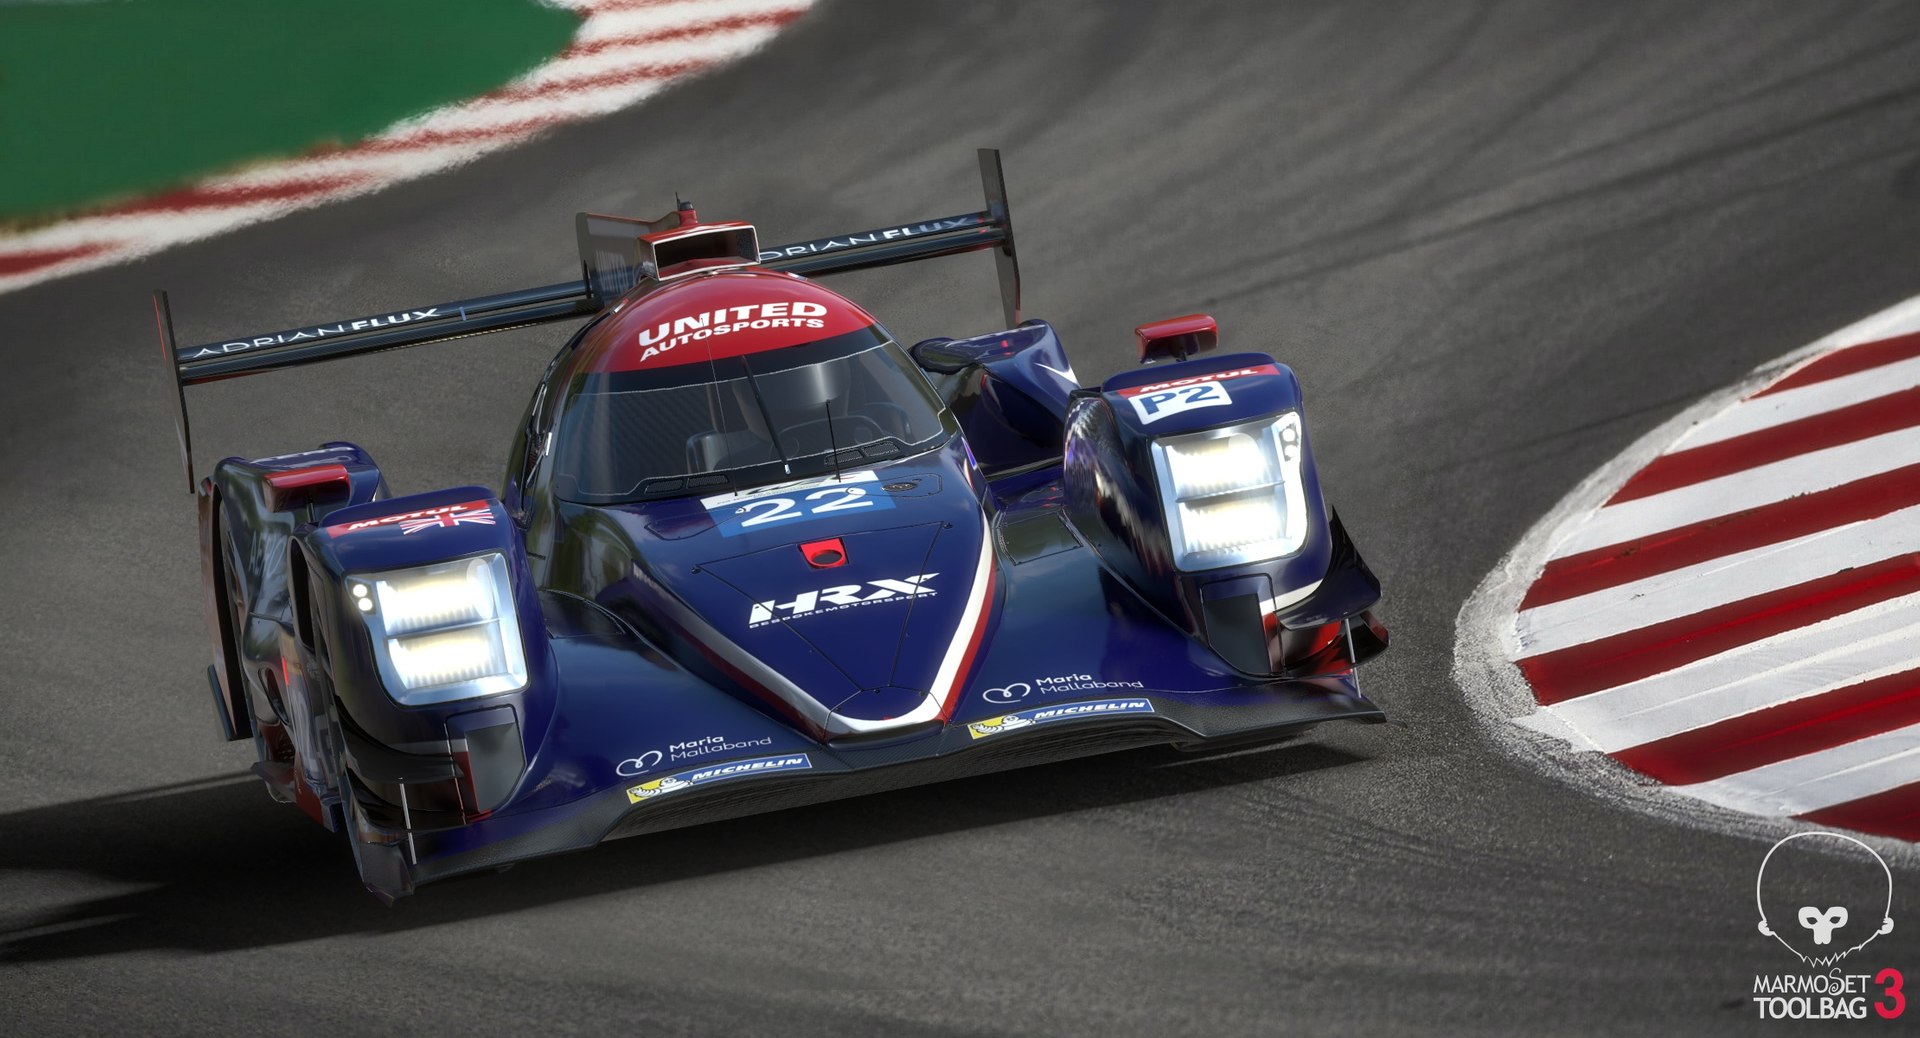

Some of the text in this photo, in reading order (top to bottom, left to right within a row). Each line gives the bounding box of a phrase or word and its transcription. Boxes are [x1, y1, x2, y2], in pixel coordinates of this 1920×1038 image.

[759, 217, 970, 261] DRIANFLUX
[638, 302, 828, 347] UNITED
[640, 317, 825, 363] AUTOSPORTS
[1139, 369, 1259, 393] MOTUL
[1139, 385, 1221, 415] P2
[347, 505, 468, 531] MOTUL
[735, 487, 874, 528] 22
[749, 572, 940, 625] HRX
[1036, 673, 1092, 687] Maria
[1040, 681, 1144, 695] Mallaband
[1034, 702, 1145, 720] MICHELIN
[669, 736, 724, 752] Maria
[671, 737, 772, 762] Mallaband
[692, 758, 803, 781] MICHELIN
